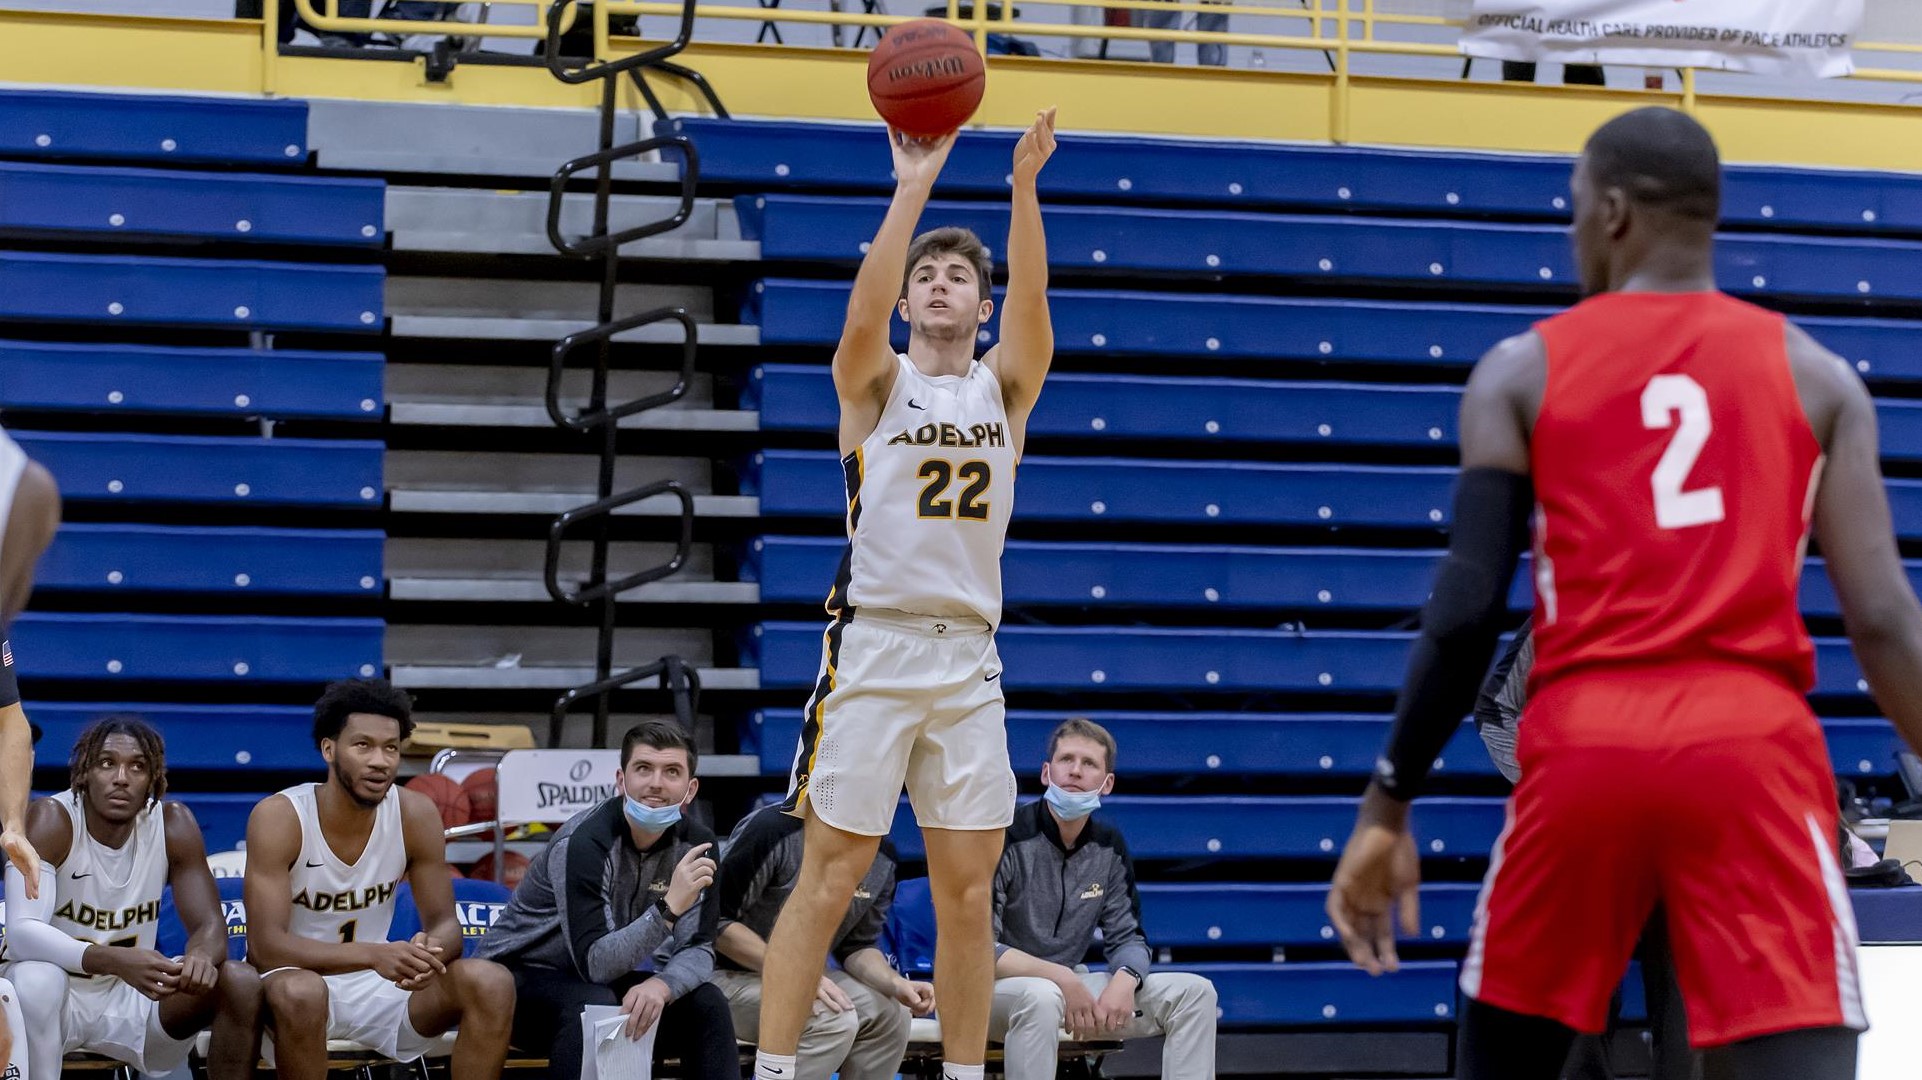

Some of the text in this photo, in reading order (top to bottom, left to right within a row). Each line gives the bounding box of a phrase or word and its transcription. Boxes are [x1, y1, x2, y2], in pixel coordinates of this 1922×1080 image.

[1547, 20, 1598, 36] HEALTH
[1603, 24, 1641, 37] CARE
[1645, 25, 1717, 41] PROVIDER
[1720, 29, 1743, 42] OF
[1743, 30, 1783, 47] PACE
[1640, 374, 1725, 530] 2
[916, 457, 991, 522] 22
[338, 918, 358, 944] 1
